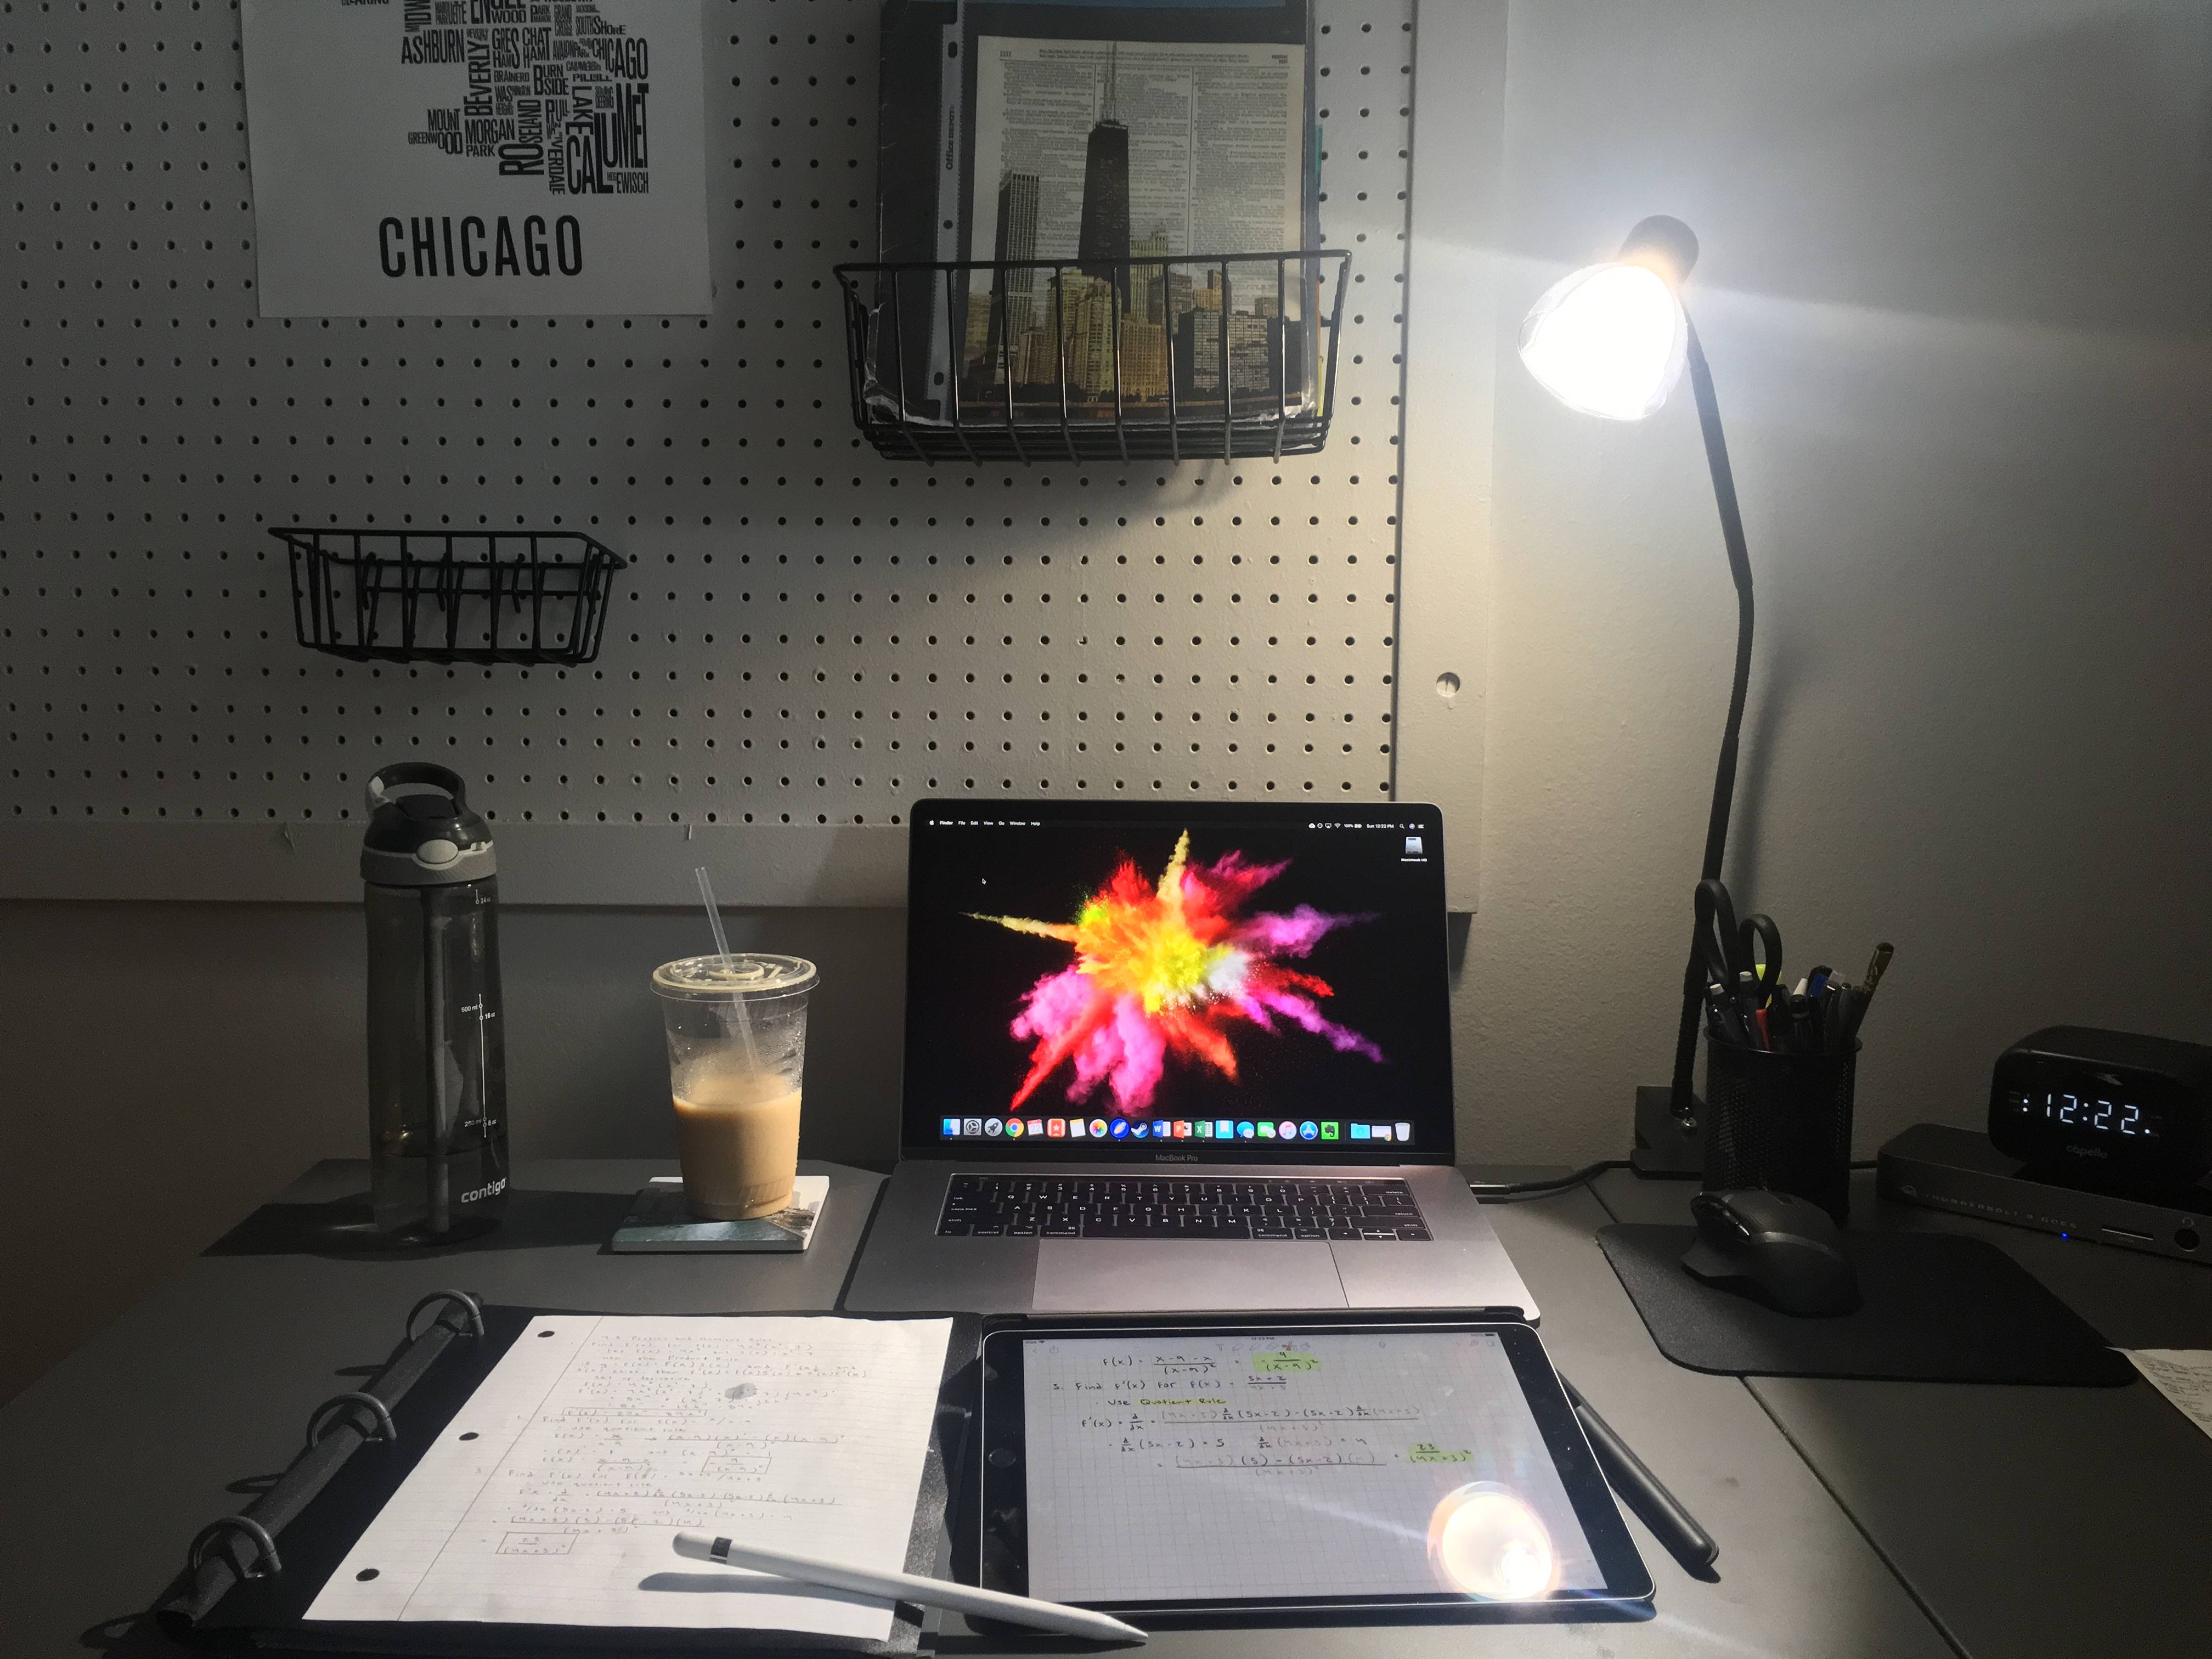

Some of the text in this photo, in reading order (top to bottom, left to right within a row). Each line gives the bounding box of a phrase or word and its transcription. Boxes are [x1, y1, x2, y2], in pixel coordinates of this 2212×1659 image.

[401, 29, 466, 65] ASHBURN
[592, 37, 648, 80] CHICAGO
[464, 40, 493, 116] BEVERLY
[494, 71, 530, 83] BRAINERD
[408, 109, 464, 154] MOUNT GREENWOOD
[565, 86, 594, 136] LAKE
[465, 119, 516, 157] MORGAN PARK
[498, 99, 545, 176] ROSELAND
[566, 83, 650, 195] CALUMET
[379, 215, 583, 278] CHICAGO
[2046, 1093, 2140, 1135] 12:22
[460, 1176, 506, 1204] contigo
[1075, 1382, 1102, 1390] Find
